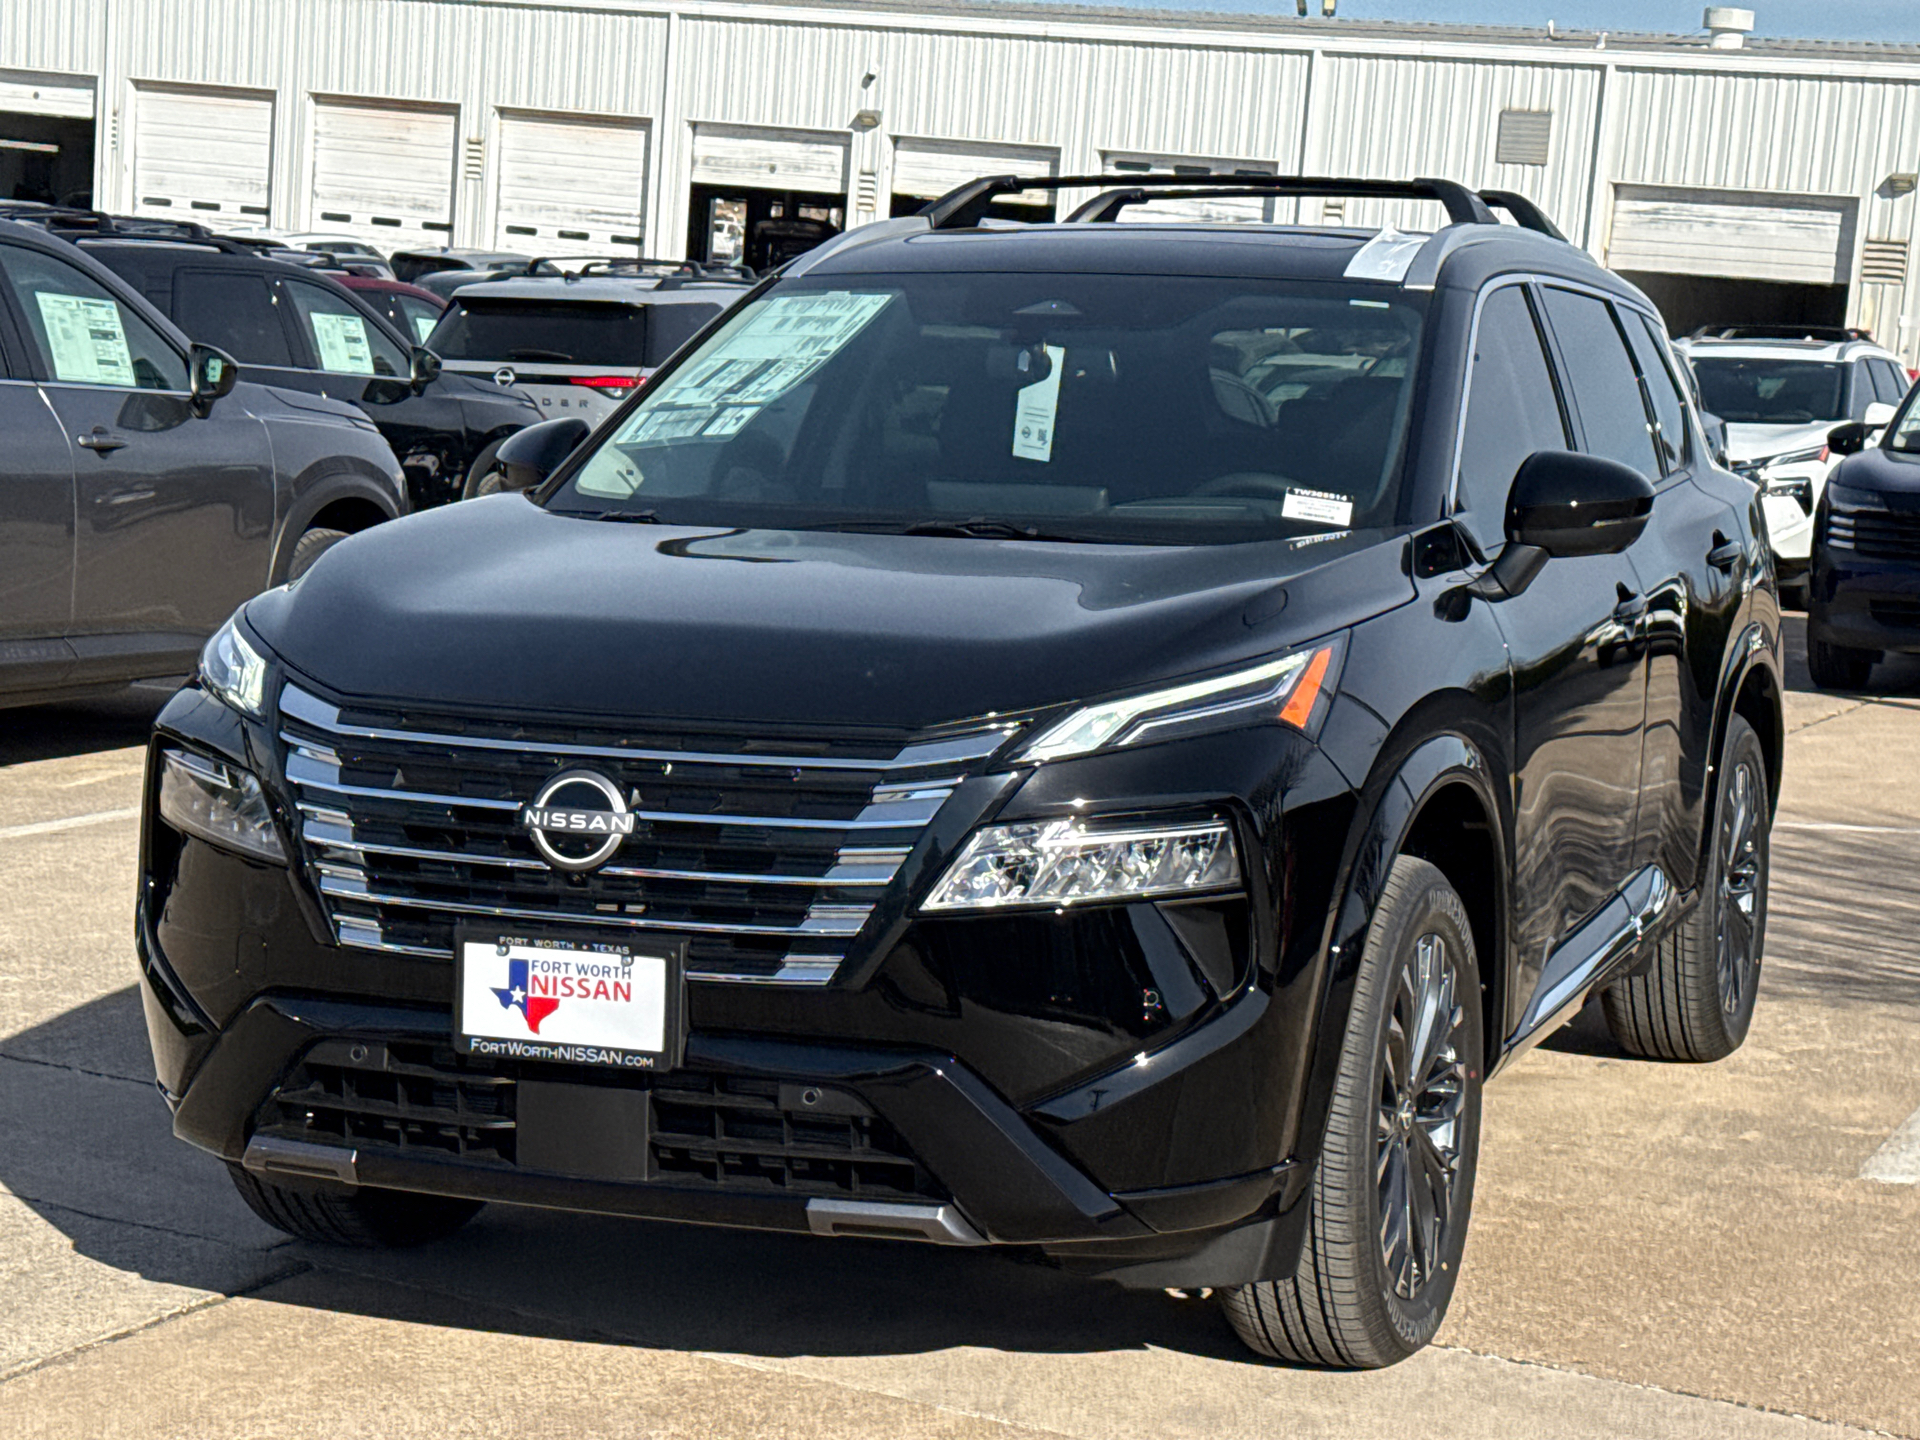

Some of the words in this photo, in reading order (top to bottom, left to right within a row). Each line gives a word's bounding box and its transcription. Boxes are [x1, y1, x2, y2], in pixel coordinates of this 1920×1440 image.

[525, 809, 630, 831] NISSAN
[499, 936, 529, 946] FORT
[534, 939, 575, 950] WORTH
[592, 943, 630, 955] TEXAS
[531, 959, 572, 975] FORT
[576, 962, 632, 979] WORTH
[531, 974, 632, 1003] NISSAN
